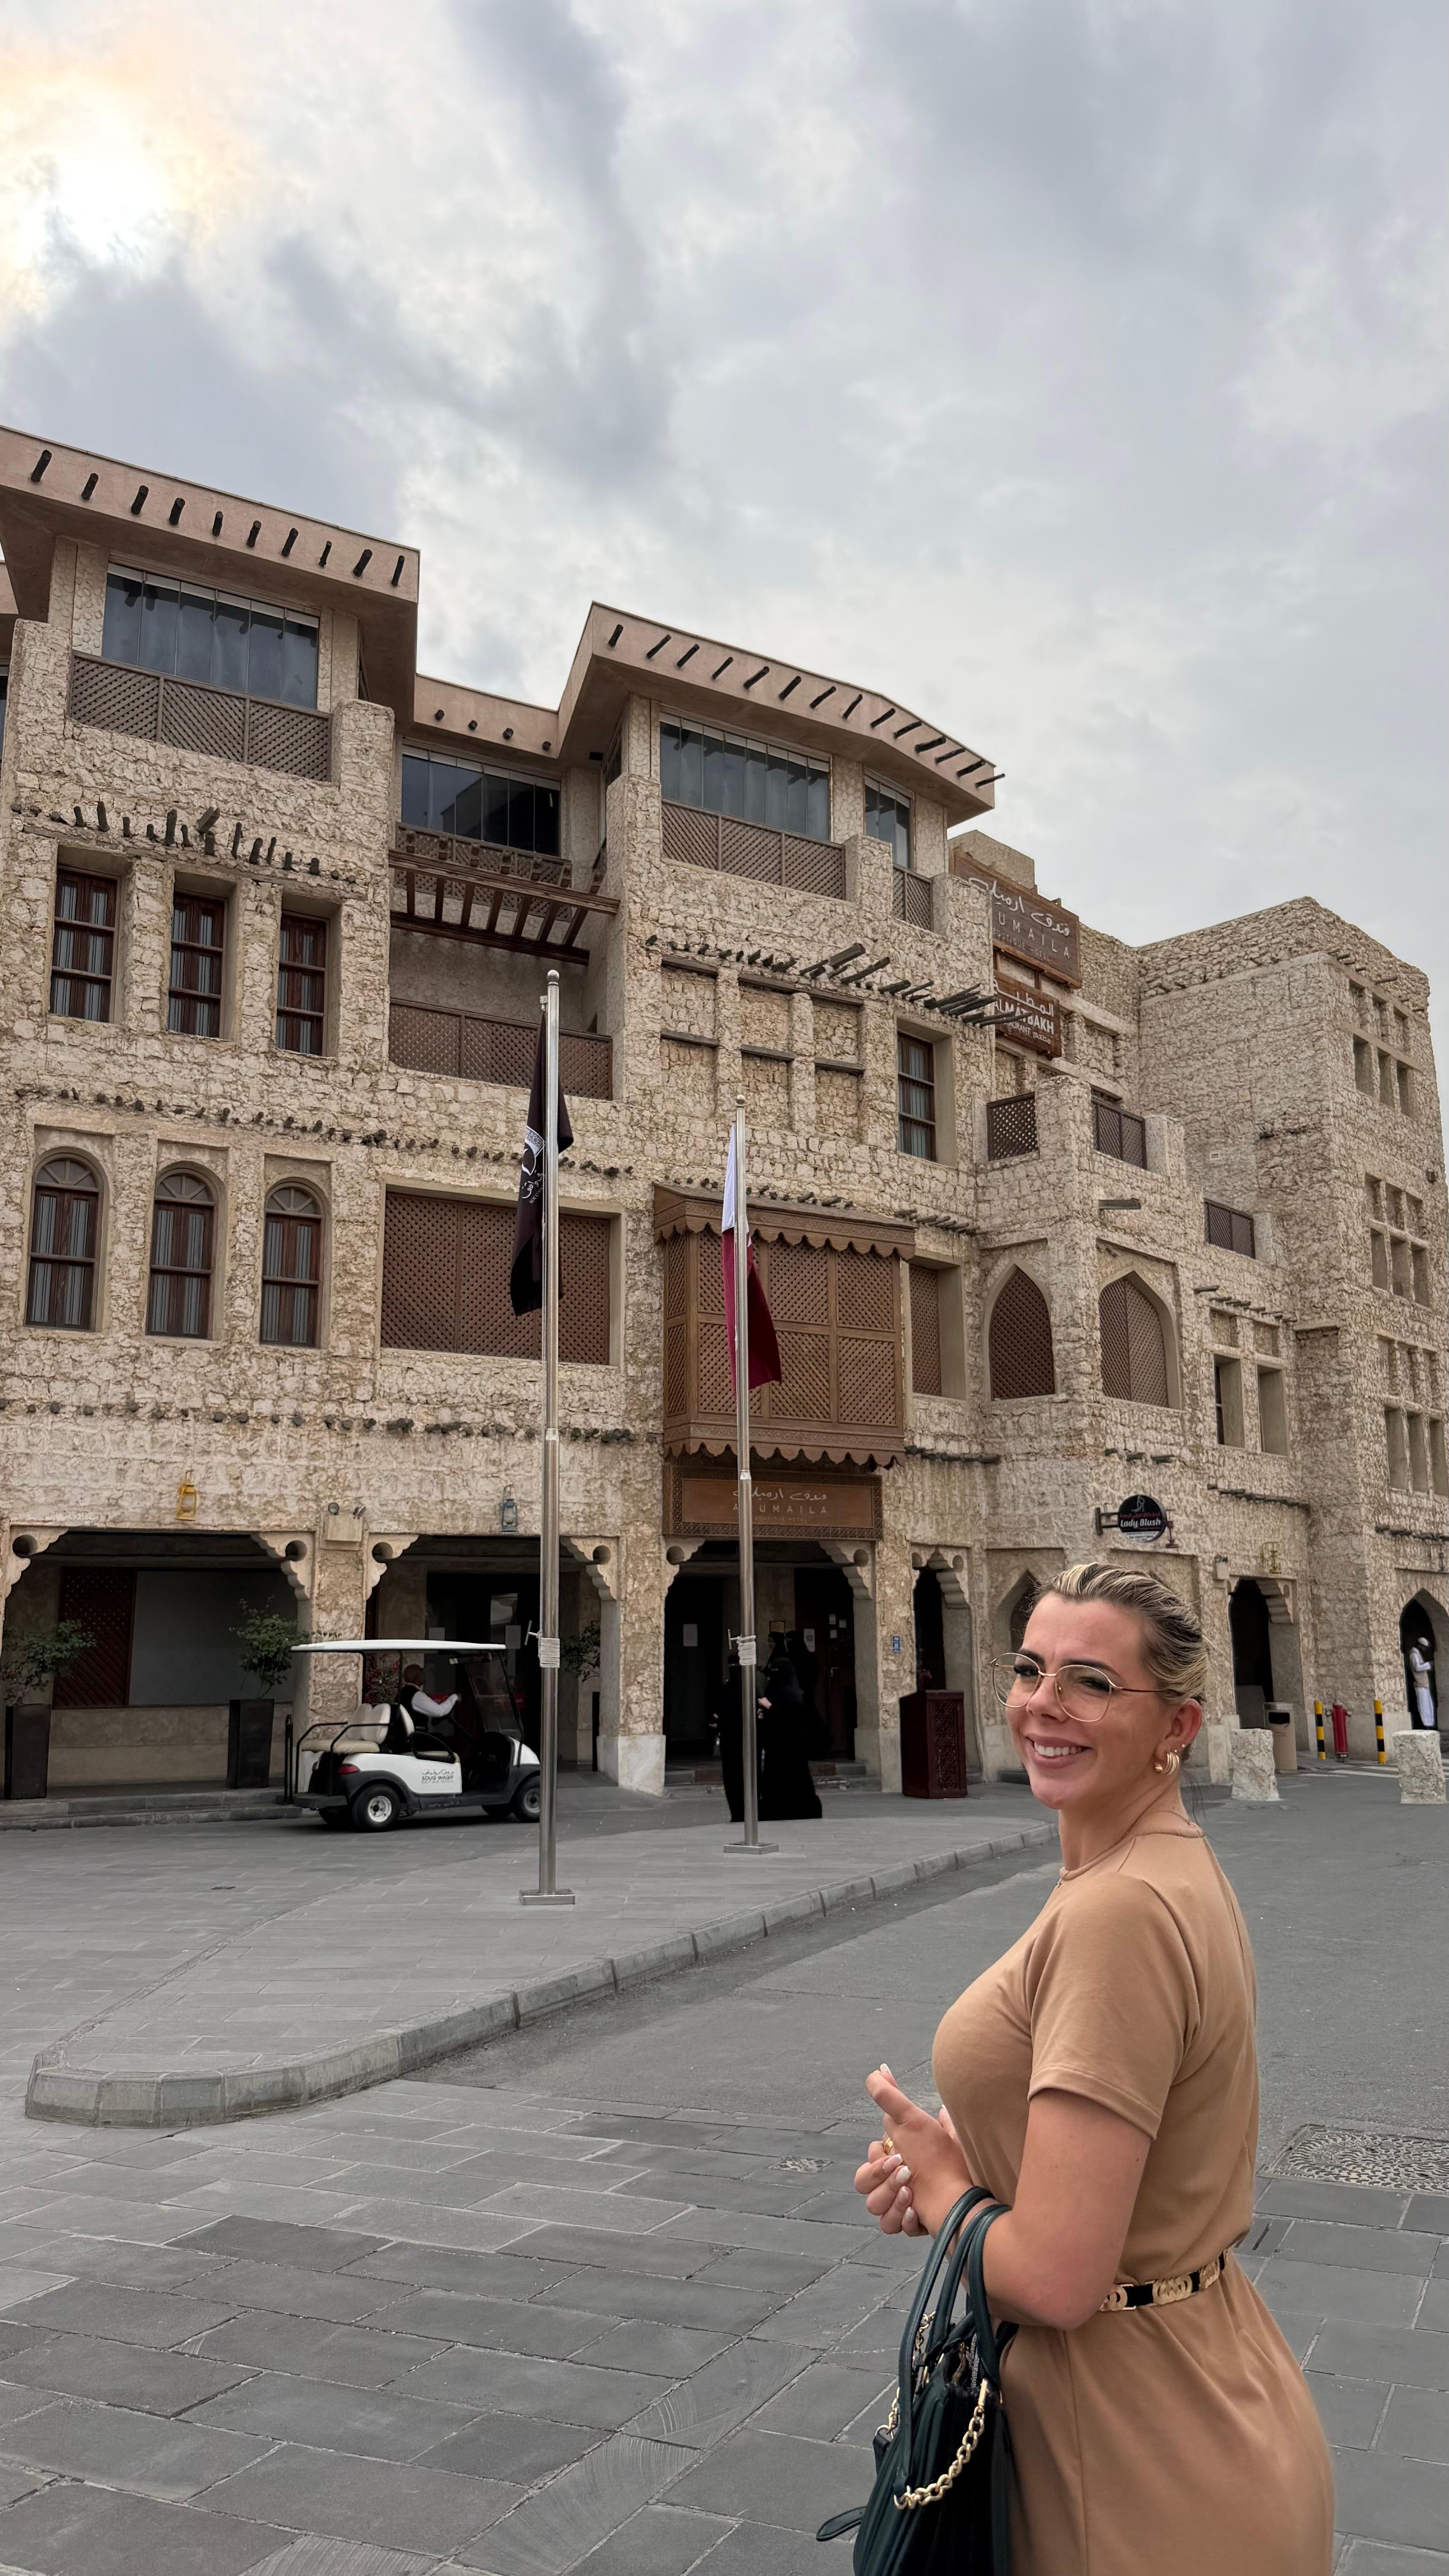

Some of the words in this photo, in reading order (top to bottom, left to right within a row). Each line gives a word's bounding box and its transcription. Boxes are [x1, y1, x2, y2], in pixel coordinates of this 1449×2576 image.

[998, 911, 1070, 959] UMAILA
[1030, 949, 1050, 962] HOTEL
[733, 1503, 827, 1514] AUMAILA
[1120, 1519, 1138, 1528] Lady
[1140, 1518, 1160, 1527] Blush
